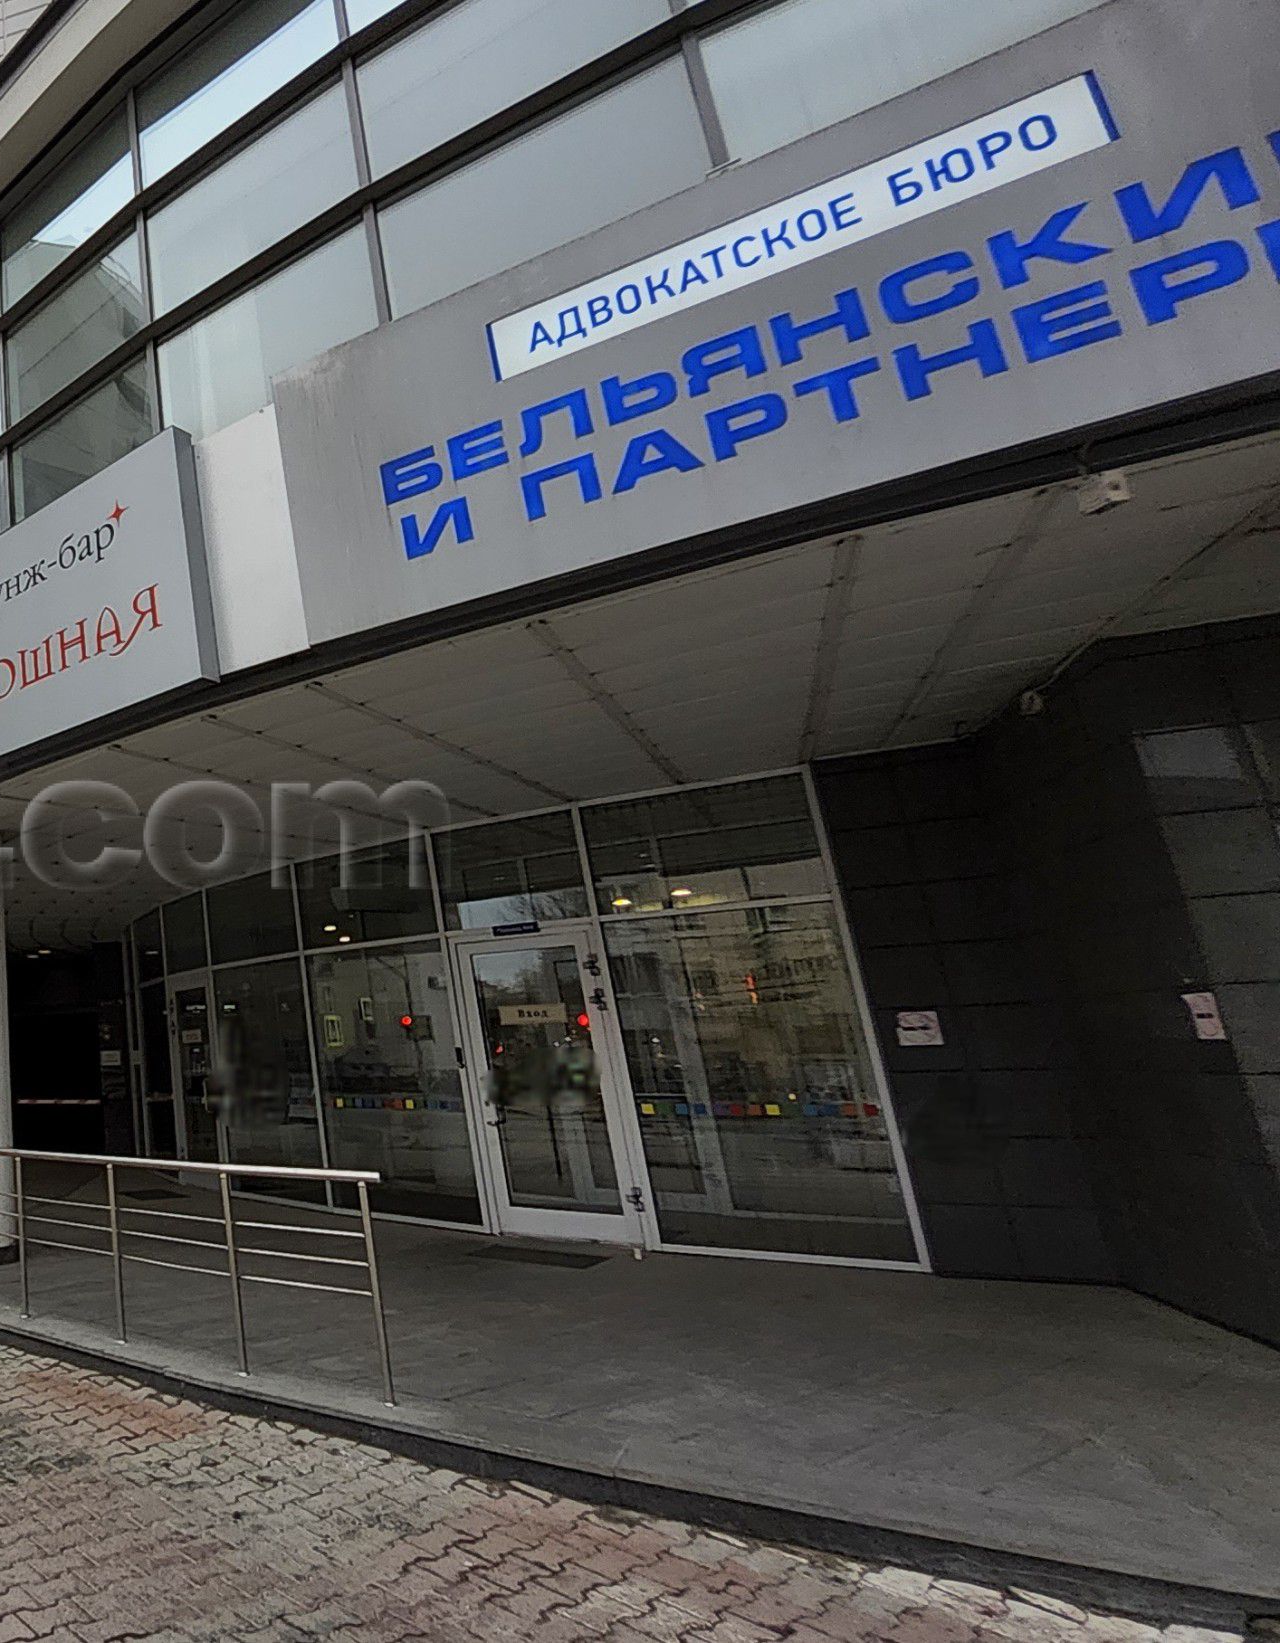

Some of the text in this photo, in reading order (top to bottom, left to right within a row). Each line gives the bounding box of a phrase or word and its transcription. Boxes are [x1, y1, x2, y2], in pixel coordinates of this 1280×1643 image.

[379, 129, 1280, 506] БЕЛЬЯНСКИ
[400, 217, 1280, 561] И ПАРТНЕР
[528, 113, 1058, 354] АДВОКАТСКОЕ БЮРО
